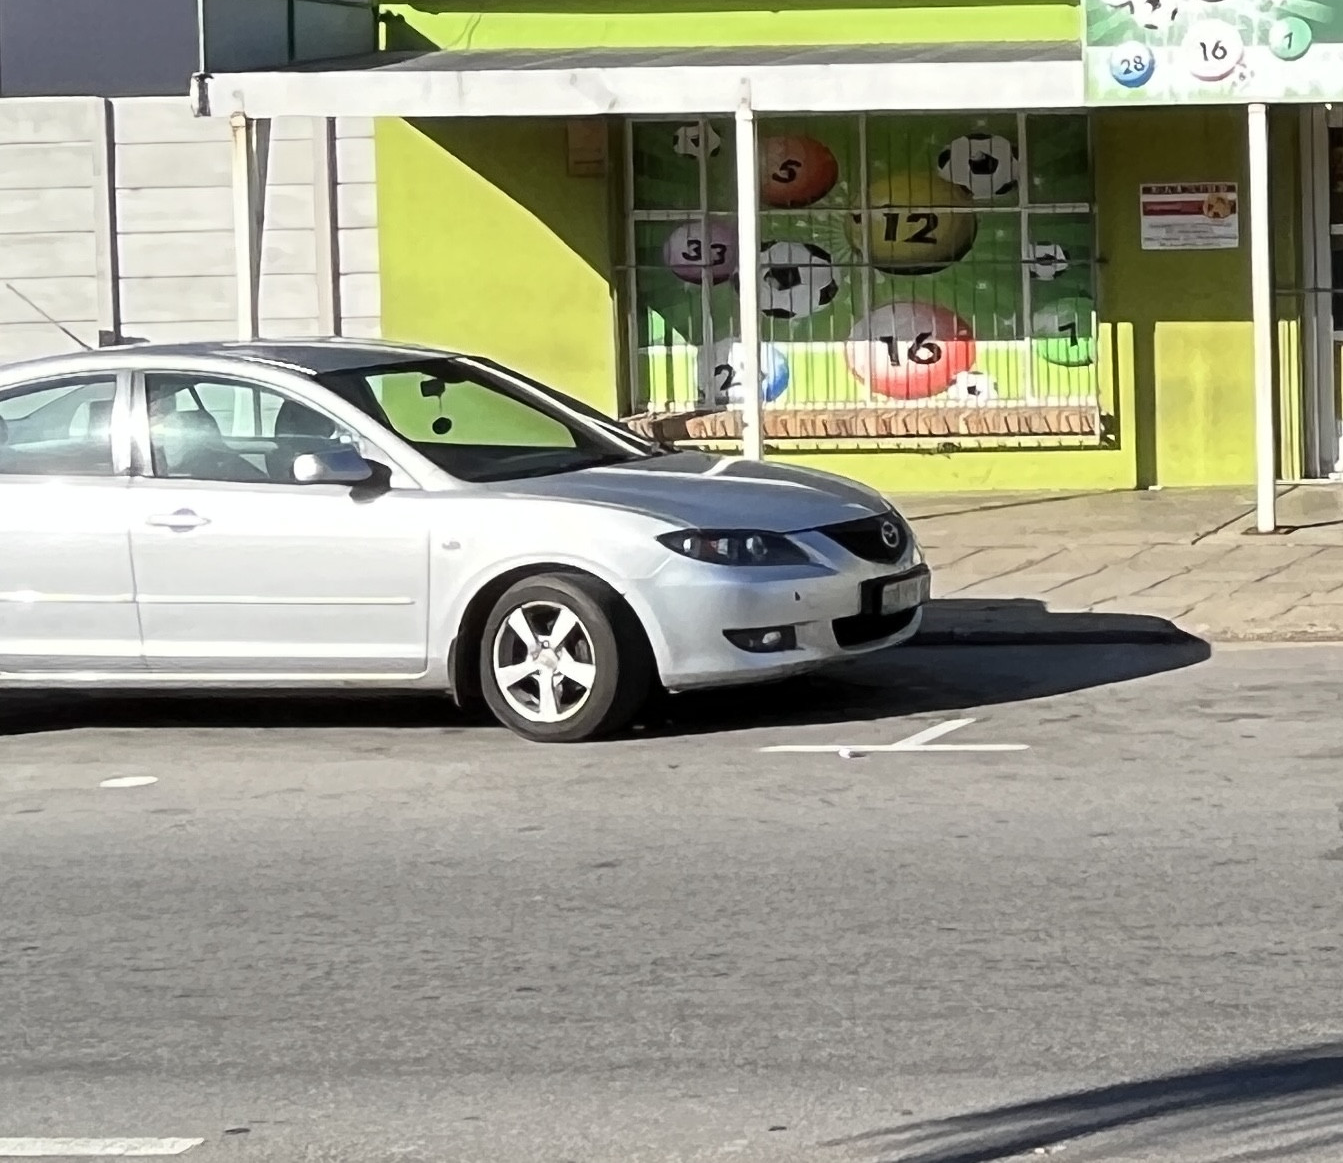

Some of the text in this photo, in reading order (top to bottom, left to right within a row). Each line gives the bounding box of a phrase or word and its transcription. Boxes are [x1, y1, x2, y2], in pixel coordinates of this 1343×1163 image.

[1200, 40, 1227, 62] 16
[1120, 55, 1145, 74] 28
[772, 159, 802, 184] 5
[883, 212, 939, 244] 12
[682, 240, 727, 266] 33
[879, 332, 942, 366] 16
